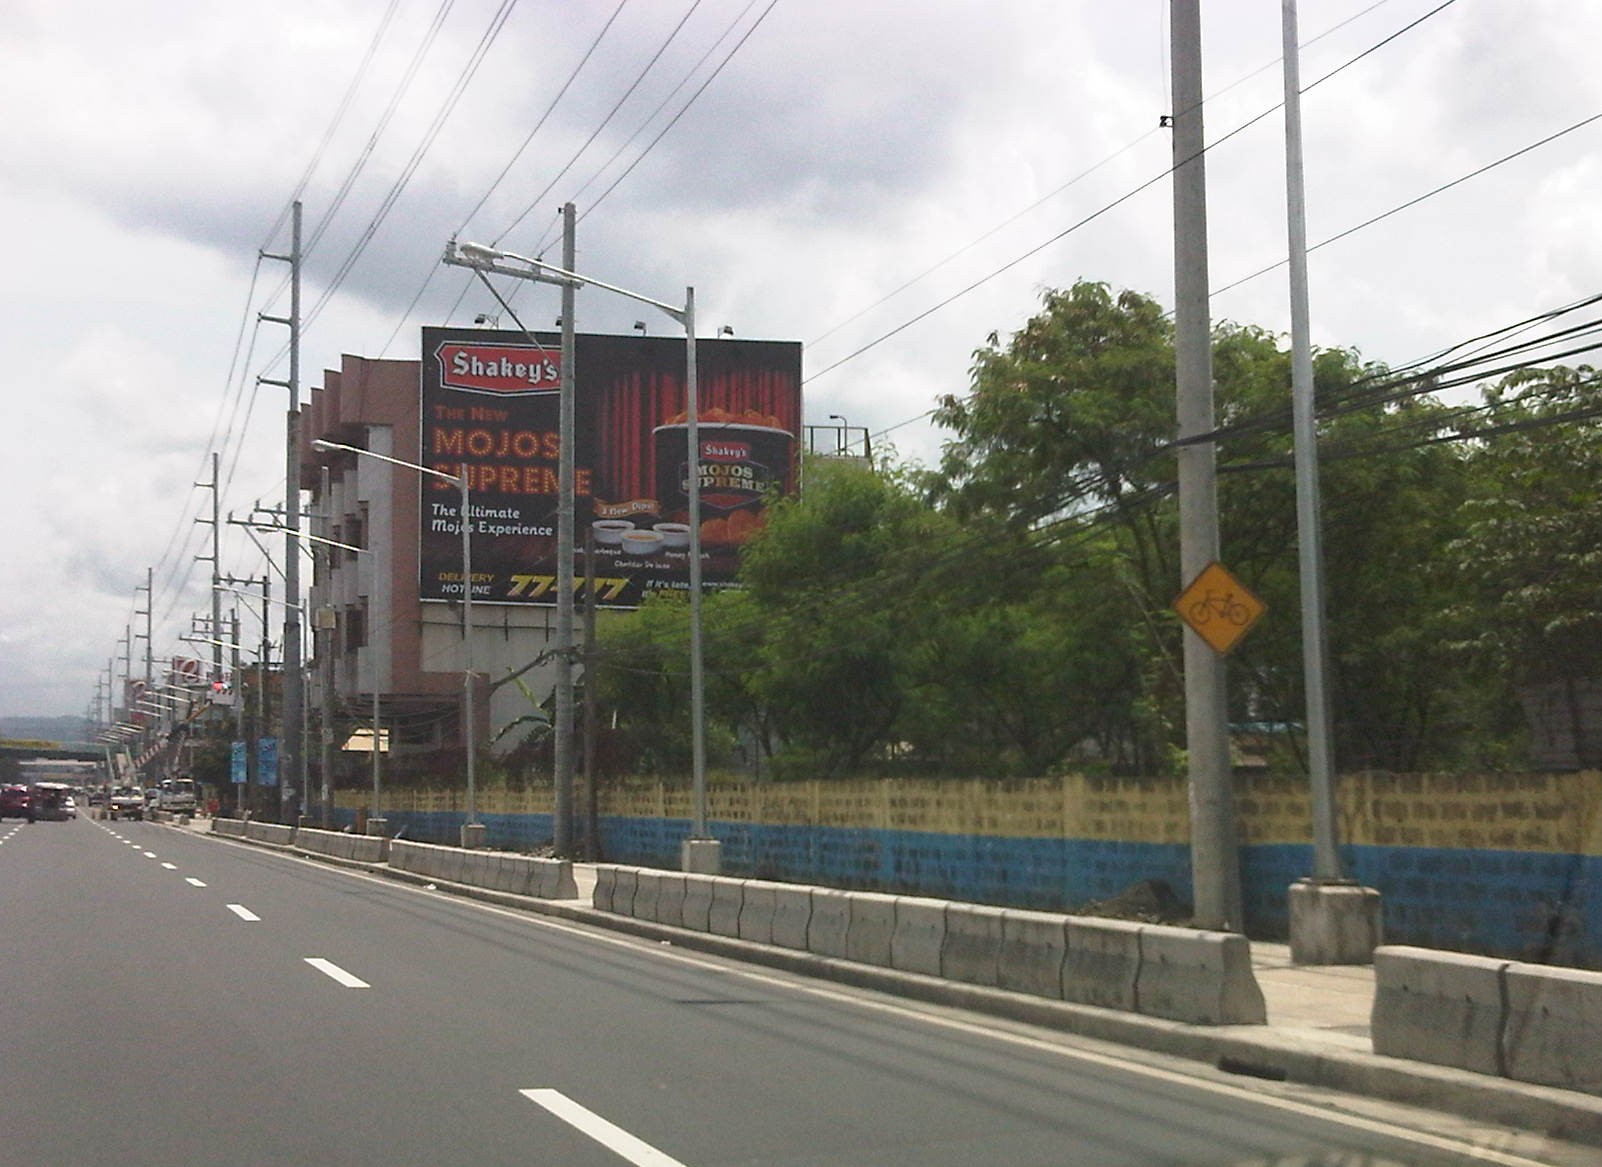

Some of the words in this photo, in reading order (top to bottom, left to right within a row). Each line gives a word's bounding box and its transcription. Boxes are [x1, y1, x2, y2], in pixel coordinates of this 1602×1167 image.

[452, 351, 558, 384] Shakey's
[432, 427, 561, 459] MOJOS
[704, 444, 747, 458] Shakey's
[697, 464, 753, 478] MOJOS
[432, 503, 456, 517] The
[461, 505, 520, 519] ltimate
[478, 521, 553, 536] Experience
[438, 572, 495, 583] DELIERY
[442, 584, 493, 595] HOTINE
